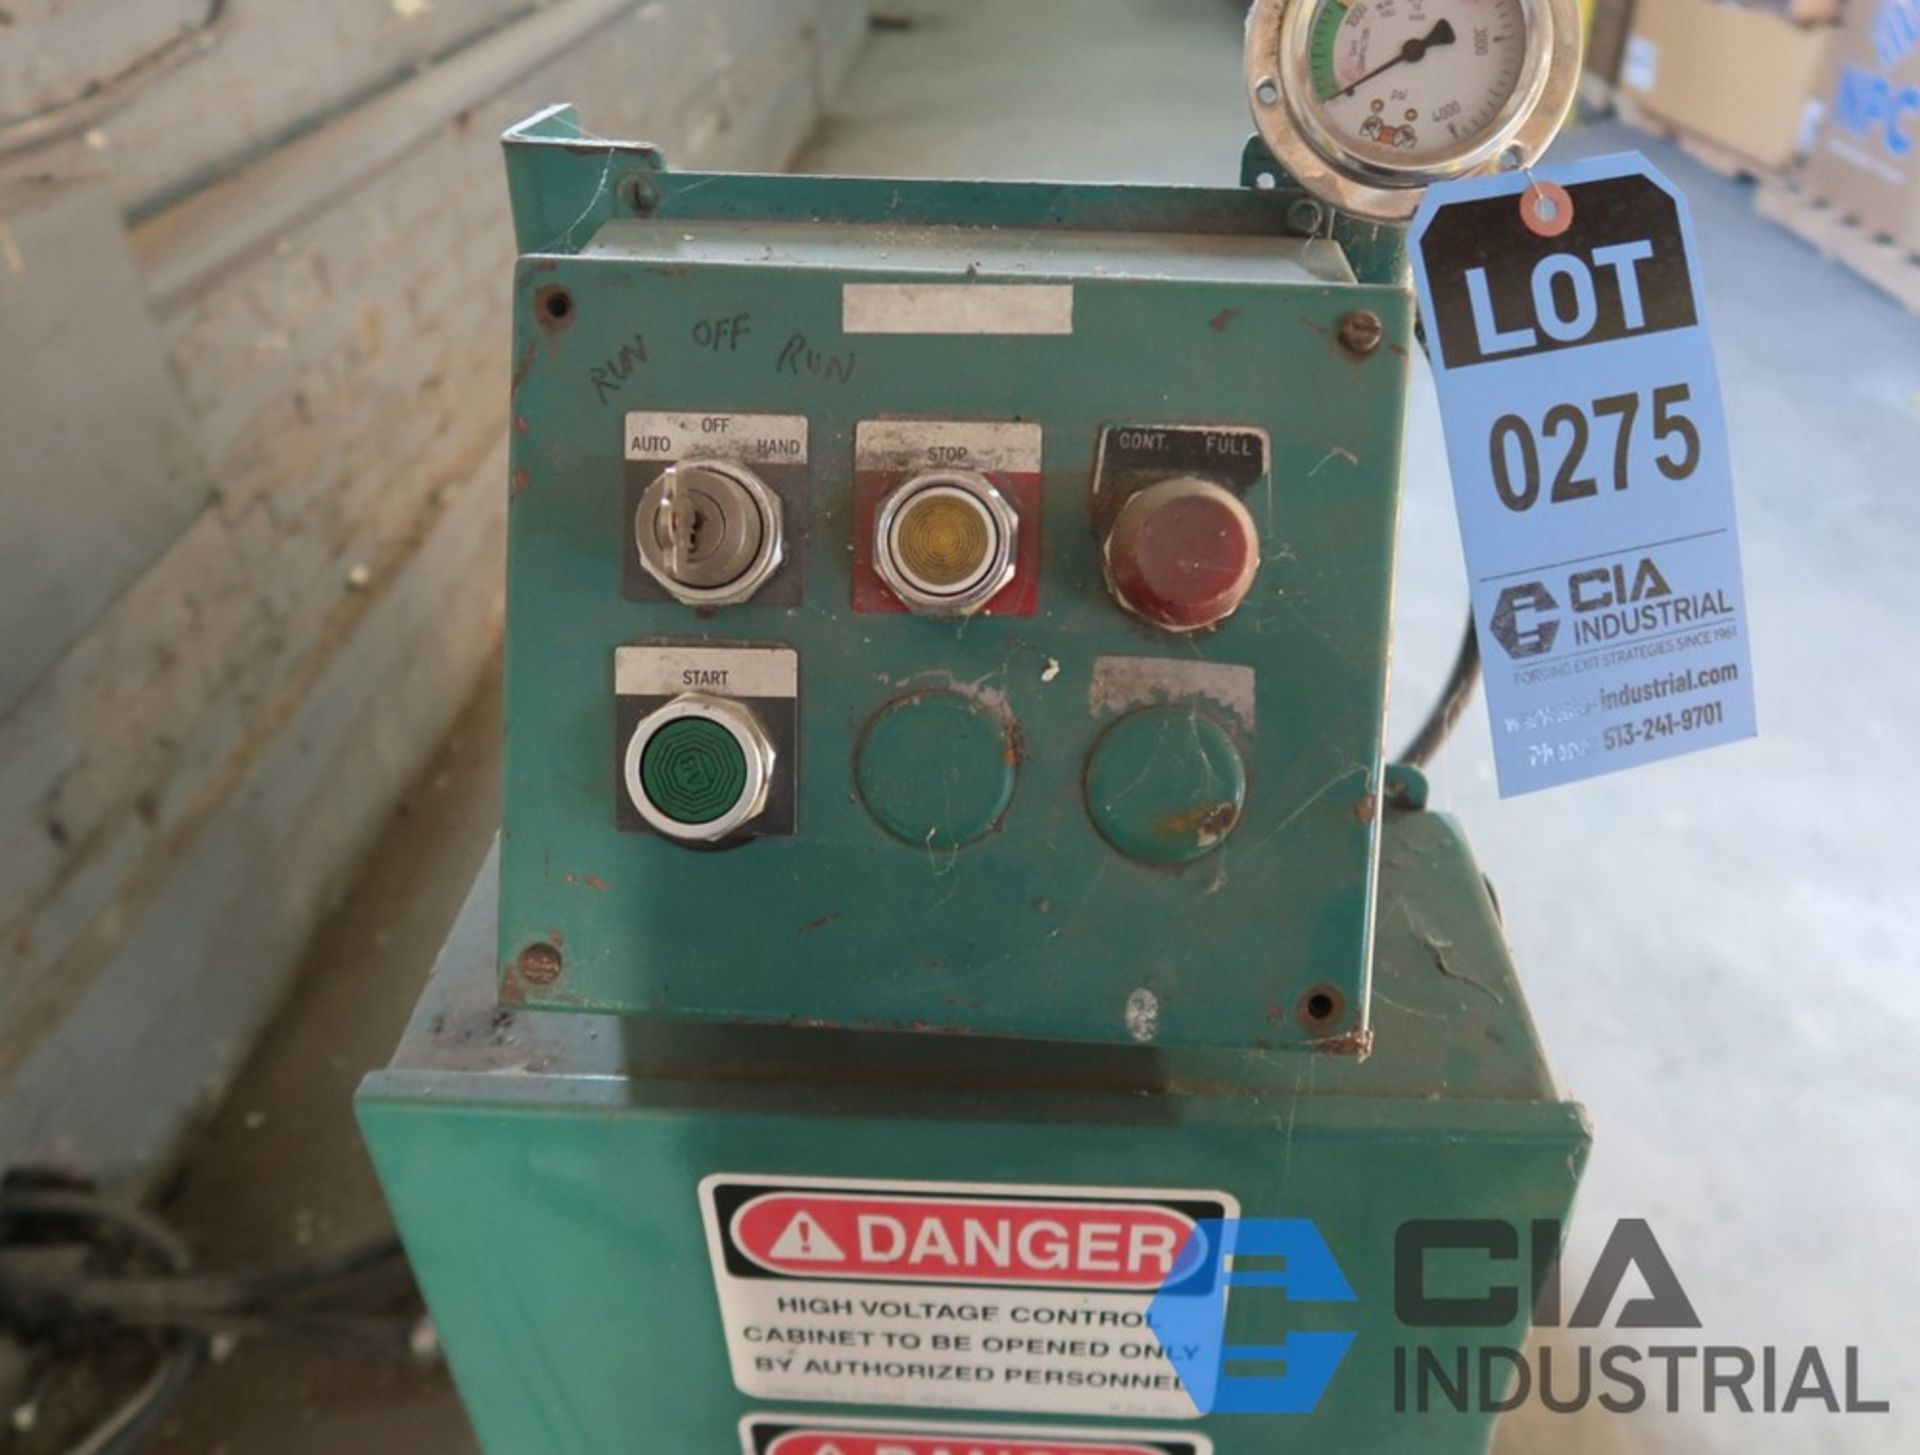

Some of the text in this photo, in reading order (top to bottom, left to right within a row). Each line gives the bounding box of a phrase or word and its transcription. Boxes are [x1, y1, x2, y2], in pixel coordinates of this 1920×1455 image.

[1431, 100, 1462, 123] 4000
[1464, 240, 1654, 356] LOT
[588, 314, 856, 405] RUN OFF RUN
[701, 416, 730, 434] OFF
[631, 435, 801, 456] AUTO HAND
[927, 446, 968, 462] STOP
[1204, 436, 1252, 456] FULL
[1489, 382, 1701, 513] 0275
[1567, 557, 1673, 614] CIA
[1574, 589, 1735, 647] INDUSTRIAL
[1676, 630, 1713, 650] SINCE
[682, 669, 730, 686] START
[1603, 700, 1724, 751] 513-241-9701
[856, 1213, 1179, 1273] DANGER
[777, 1297, 1161, 1329] HIGH VOLTAGE CONTROL
[742, 1326, 1200, 1361] CABINET TO BE OPENED ONLY
[754, 1356, 1190, 1391] BY AUTHORIZED PERSONNEL
